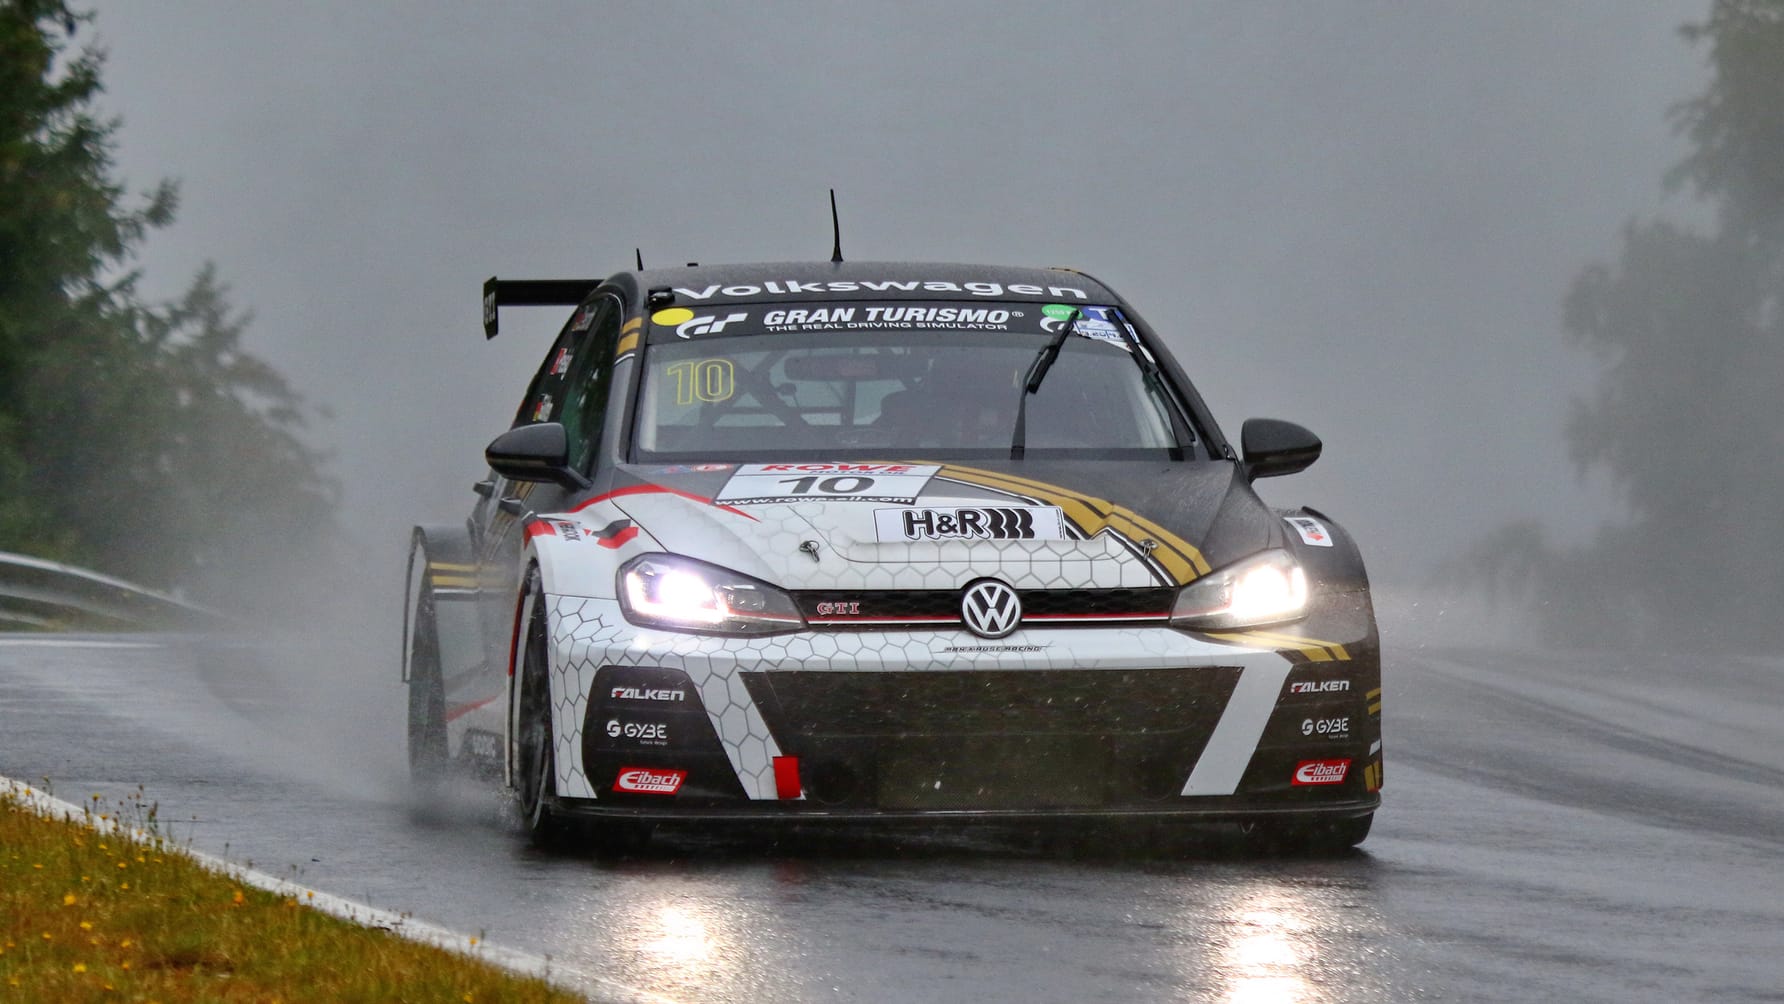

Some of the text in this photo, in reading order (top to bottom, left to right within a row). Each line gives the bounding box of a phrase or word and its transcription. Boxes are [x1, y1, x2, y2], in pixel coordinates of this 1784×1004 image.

[672, 280, 1088, 299] Volkswagen
[763, 307, 855, 325] GRAN
[766, 324, 798, 332] THE
[916, 322, 1008, 330] SIMULATOR
[667, 358, 734, 405] 10
[761, 464, 917, 472] ROWE
[779, 476, 875, 494] 10
[902, 509, 990, 540] H&R
[816, 602, 860, 615] GTI
[611, 687, 685, 701] FALKEN
[1290, 680, 1350, 693] FALKEN
[618, 770, 681, 792] Eibach
[1296, 761, 1346, 783] Eibach
